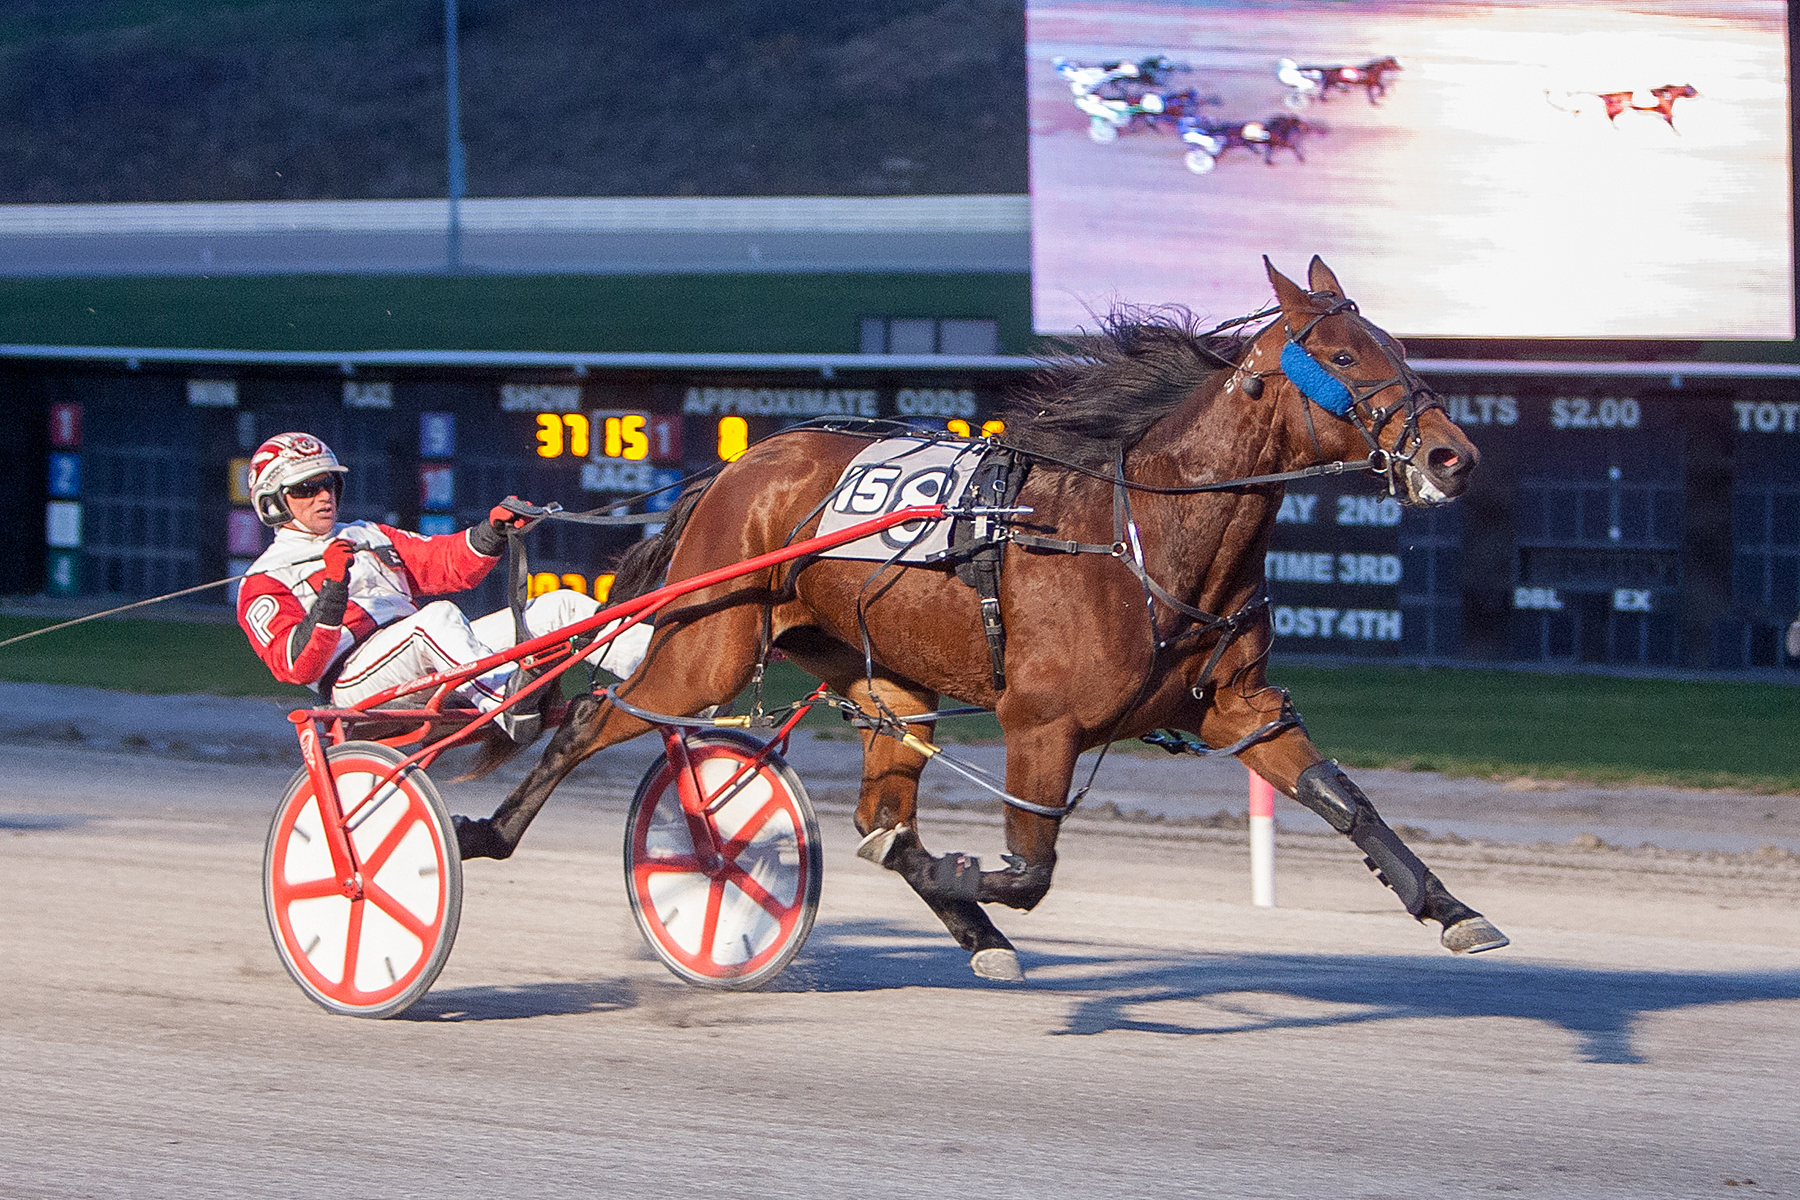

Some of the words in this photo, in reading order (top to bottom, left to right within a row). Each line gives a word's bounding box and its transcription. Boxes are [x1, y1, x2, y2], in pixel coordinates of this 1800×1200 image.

[683, 388, 878, 417] APPROXIMATE
[896, 389, 977, 418] ODDS
[1551, 398, 1641, 429] $2.00
[1734, 401, 1800, 432] TOT
[535, 413, 589, 458] 37
[604, 414, 649, 461] 15
[655, 421, 671, 455] 1
[581, 464, 652, 492] RACE
[833, 463, 902, 515] 15
[1336, 495, 1402, 526] 2ND
[1265, 552, 1334, 583] TIME
[1338, 554, 1402, 584] 3RD
[1514, 587, 1563, 610] DBL
[1613, 588, 1651, 611] EX
[245, 594, 280, 648] P
[1337, 609, 1402, 640] 4TH
